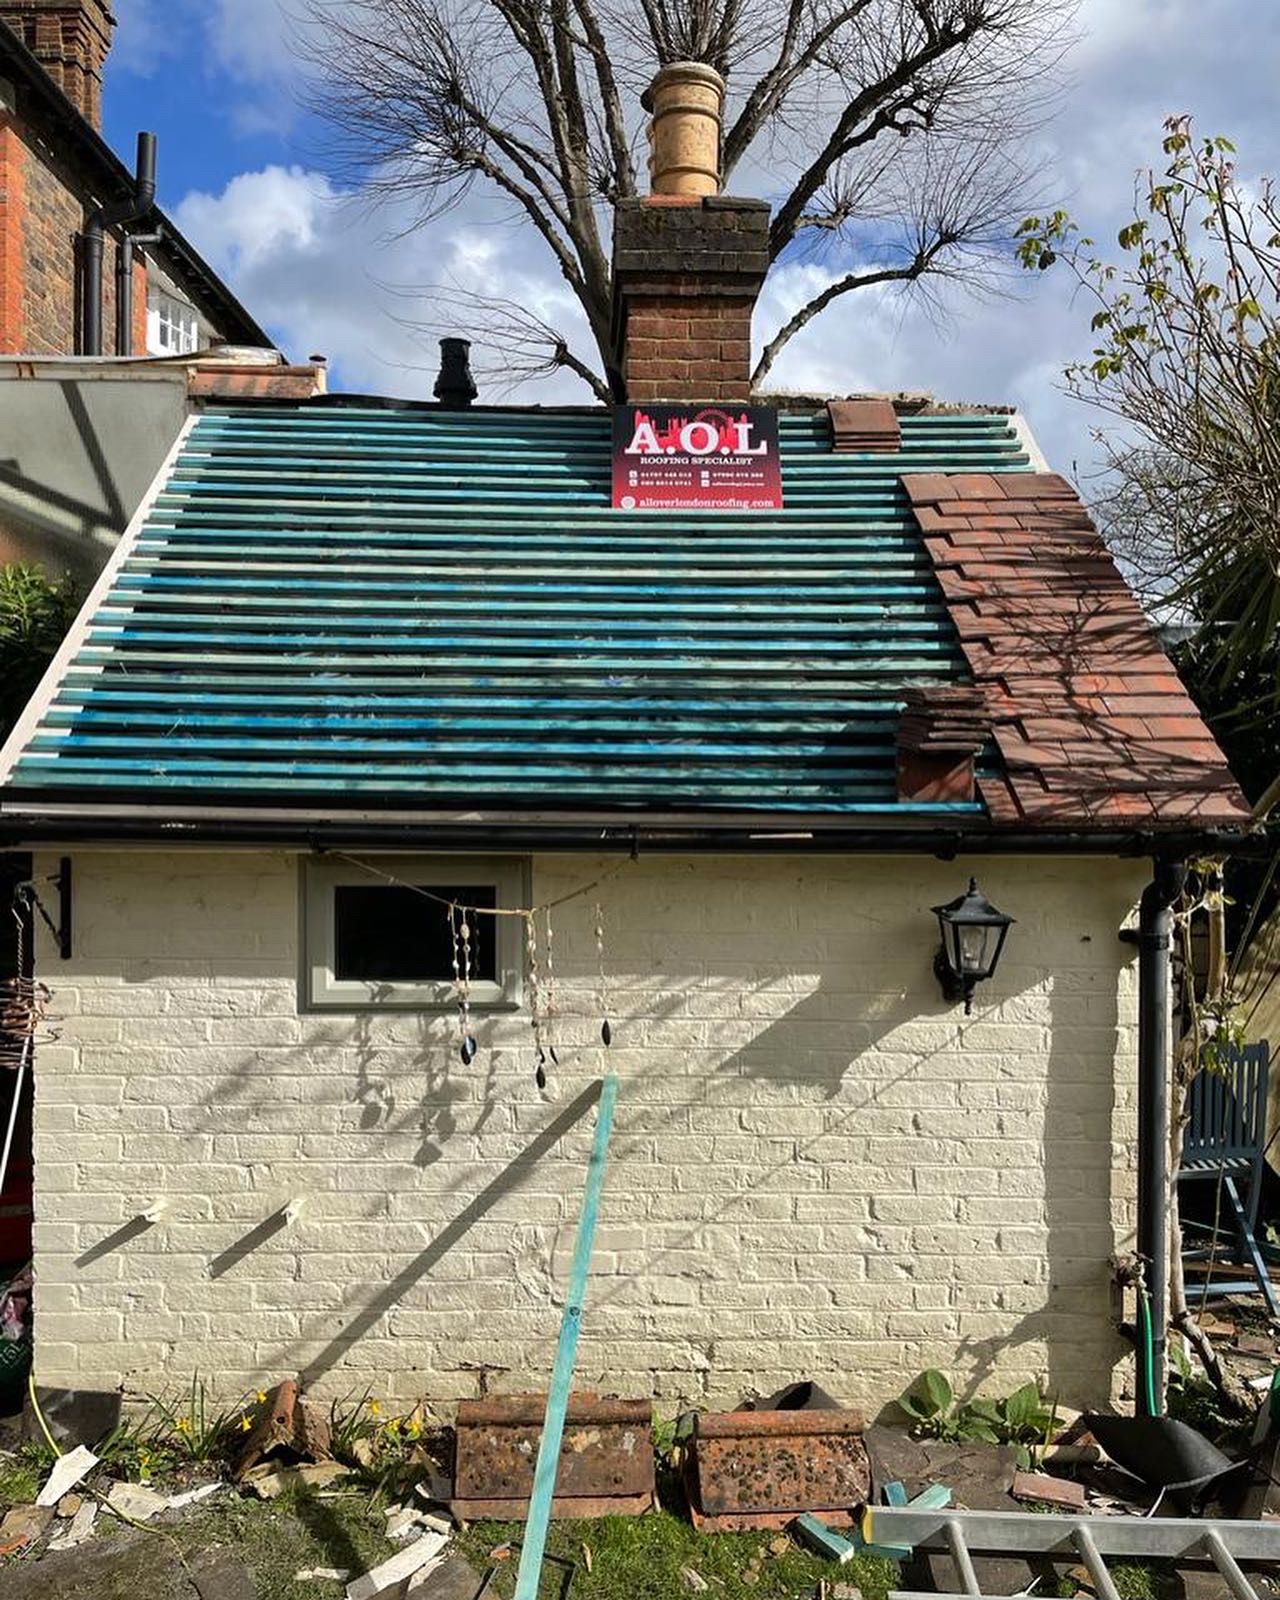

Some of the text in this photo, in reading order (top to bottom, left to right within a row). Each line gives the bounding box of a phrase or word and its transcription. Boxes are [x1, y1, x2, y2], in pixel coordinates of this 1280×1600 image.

[624, 421, 768, 456] A.O.L
[640, 456, 753, 466] ROOFING SPECIALIST
[639, 498, 774, 509] alloverlondonroofing.com
